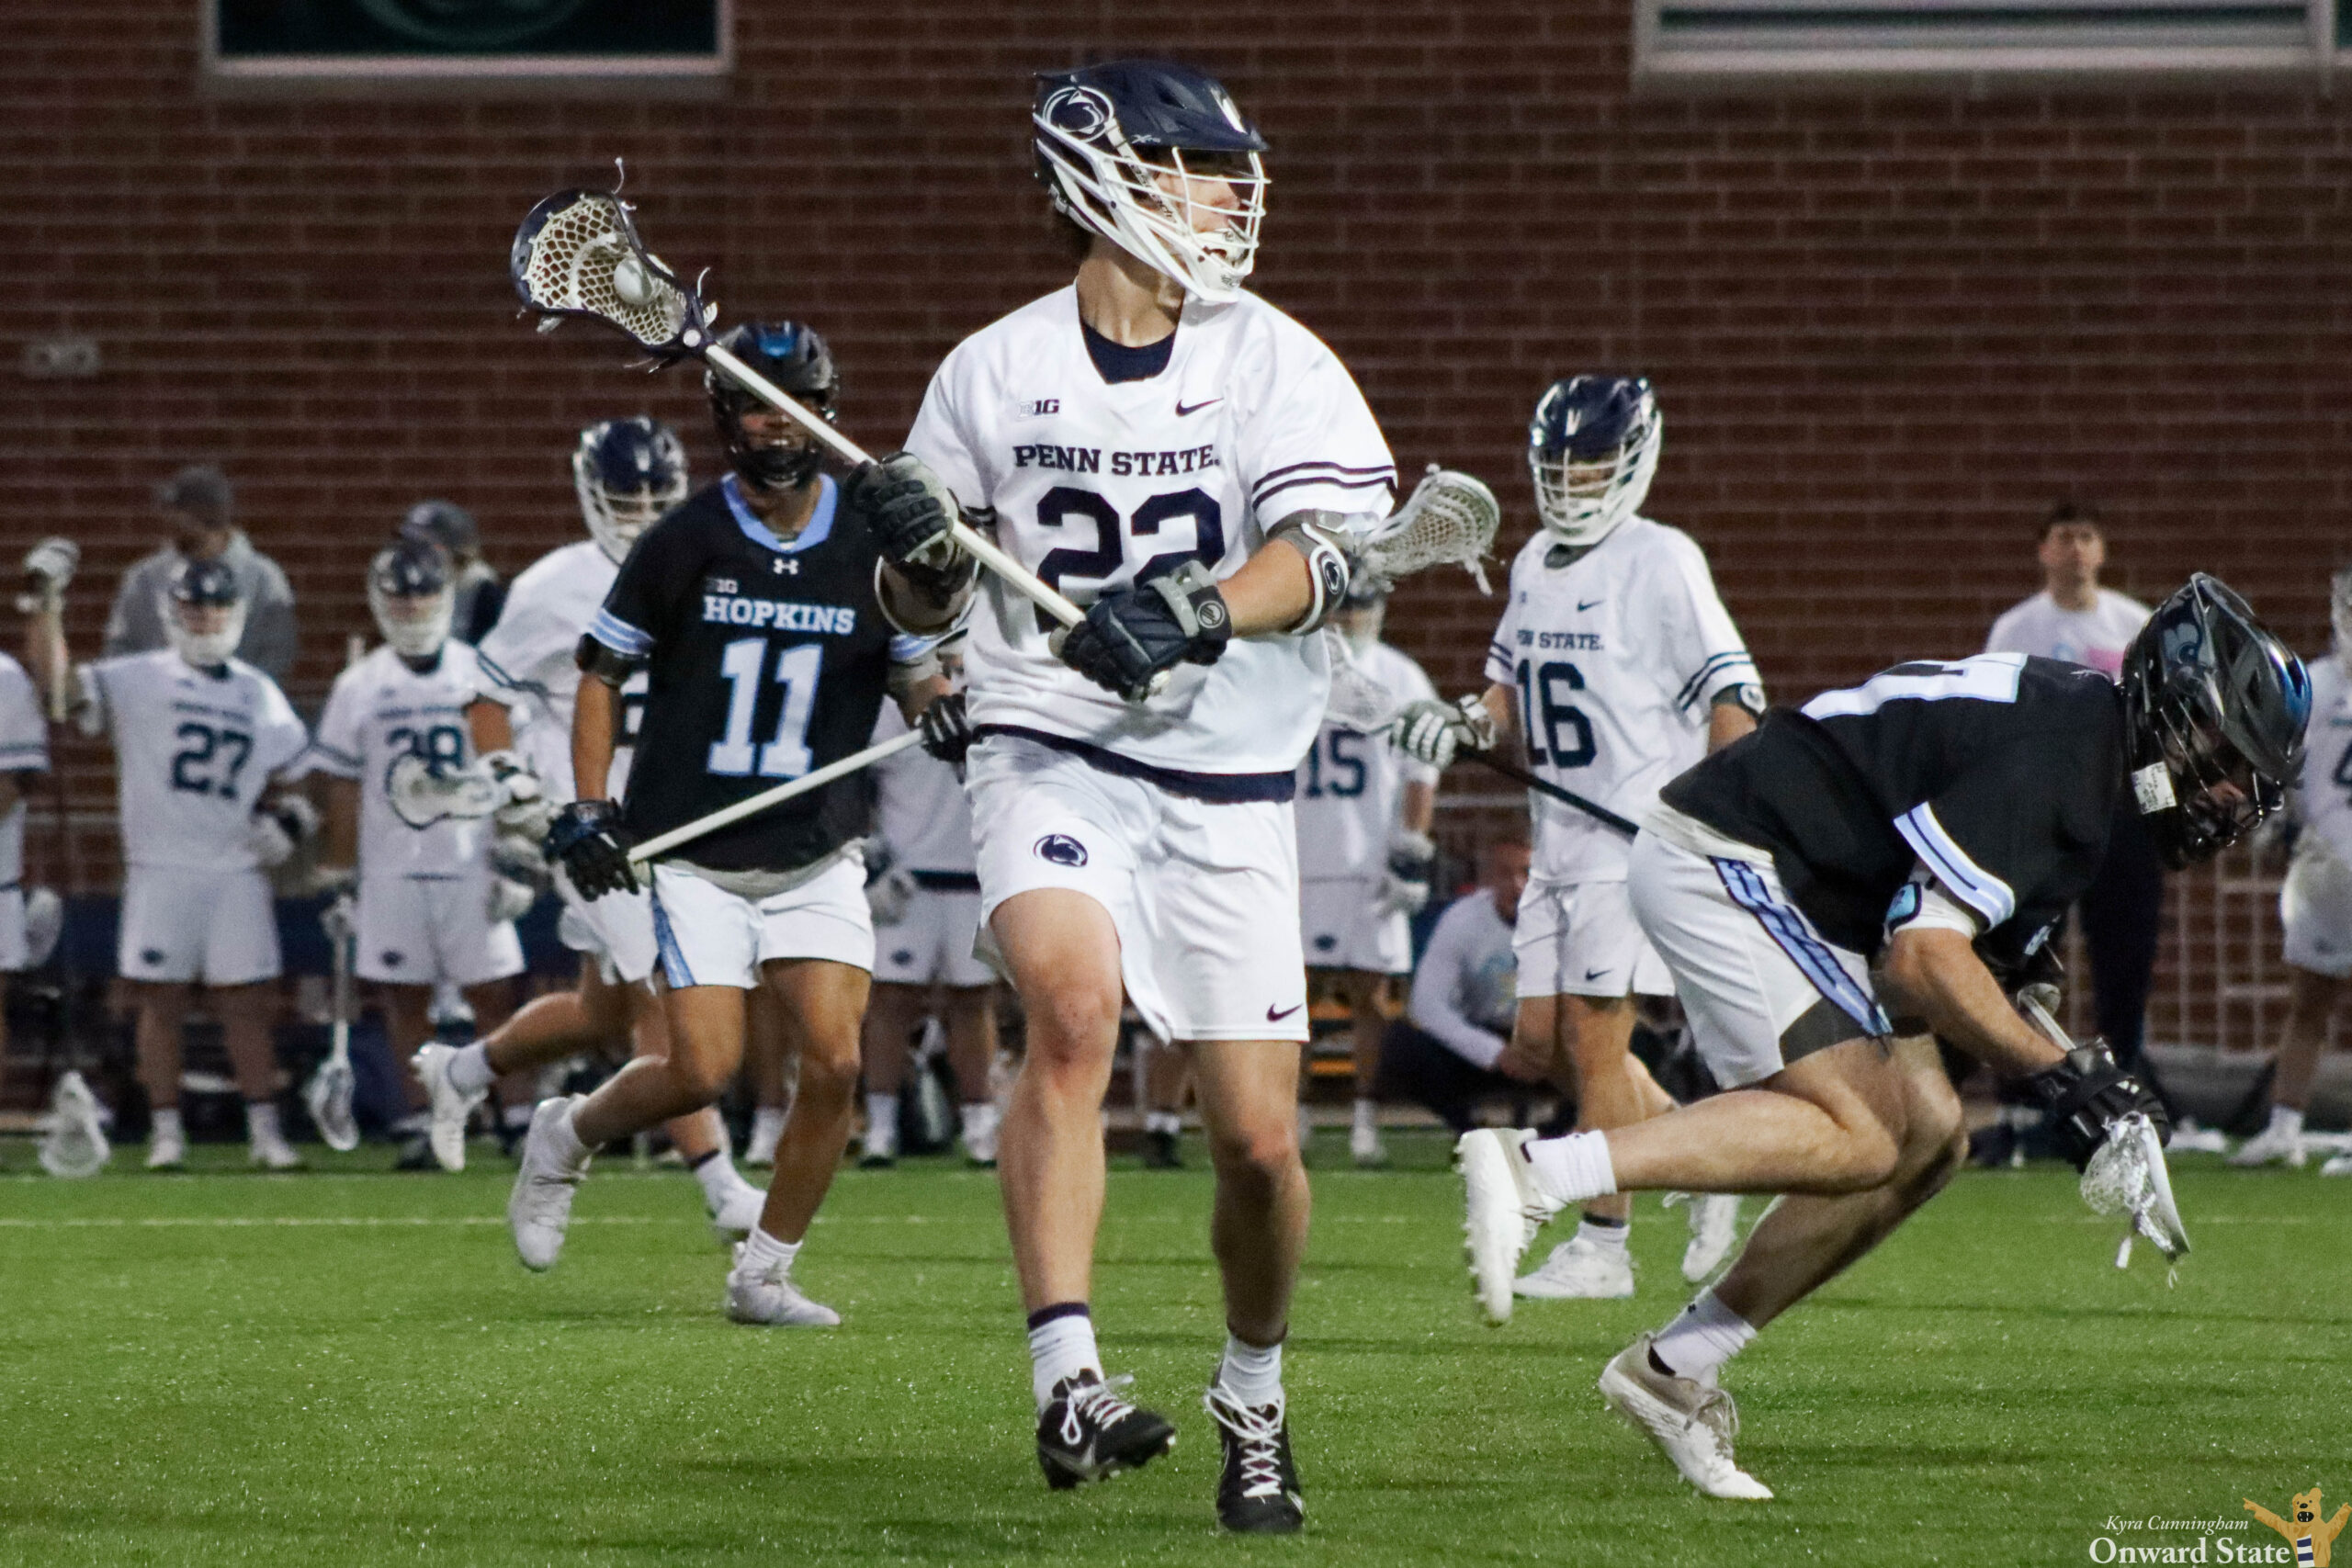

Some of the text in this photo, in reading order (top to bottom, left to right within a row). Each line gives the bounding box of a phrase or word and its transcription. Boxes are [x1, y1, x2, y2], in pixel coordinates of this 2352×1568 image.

[1012, 444, 1214, 477] PENN STATE
[1035, 486, 1227, 635] 22
[702, 595, 856, 636] HOPKINS
[707, 637, 823, 779] 11
[1516, 659, 1598, 768] 16
[171, 722, 254, 799] 27
[1306, 728, 1367, 798] 15
